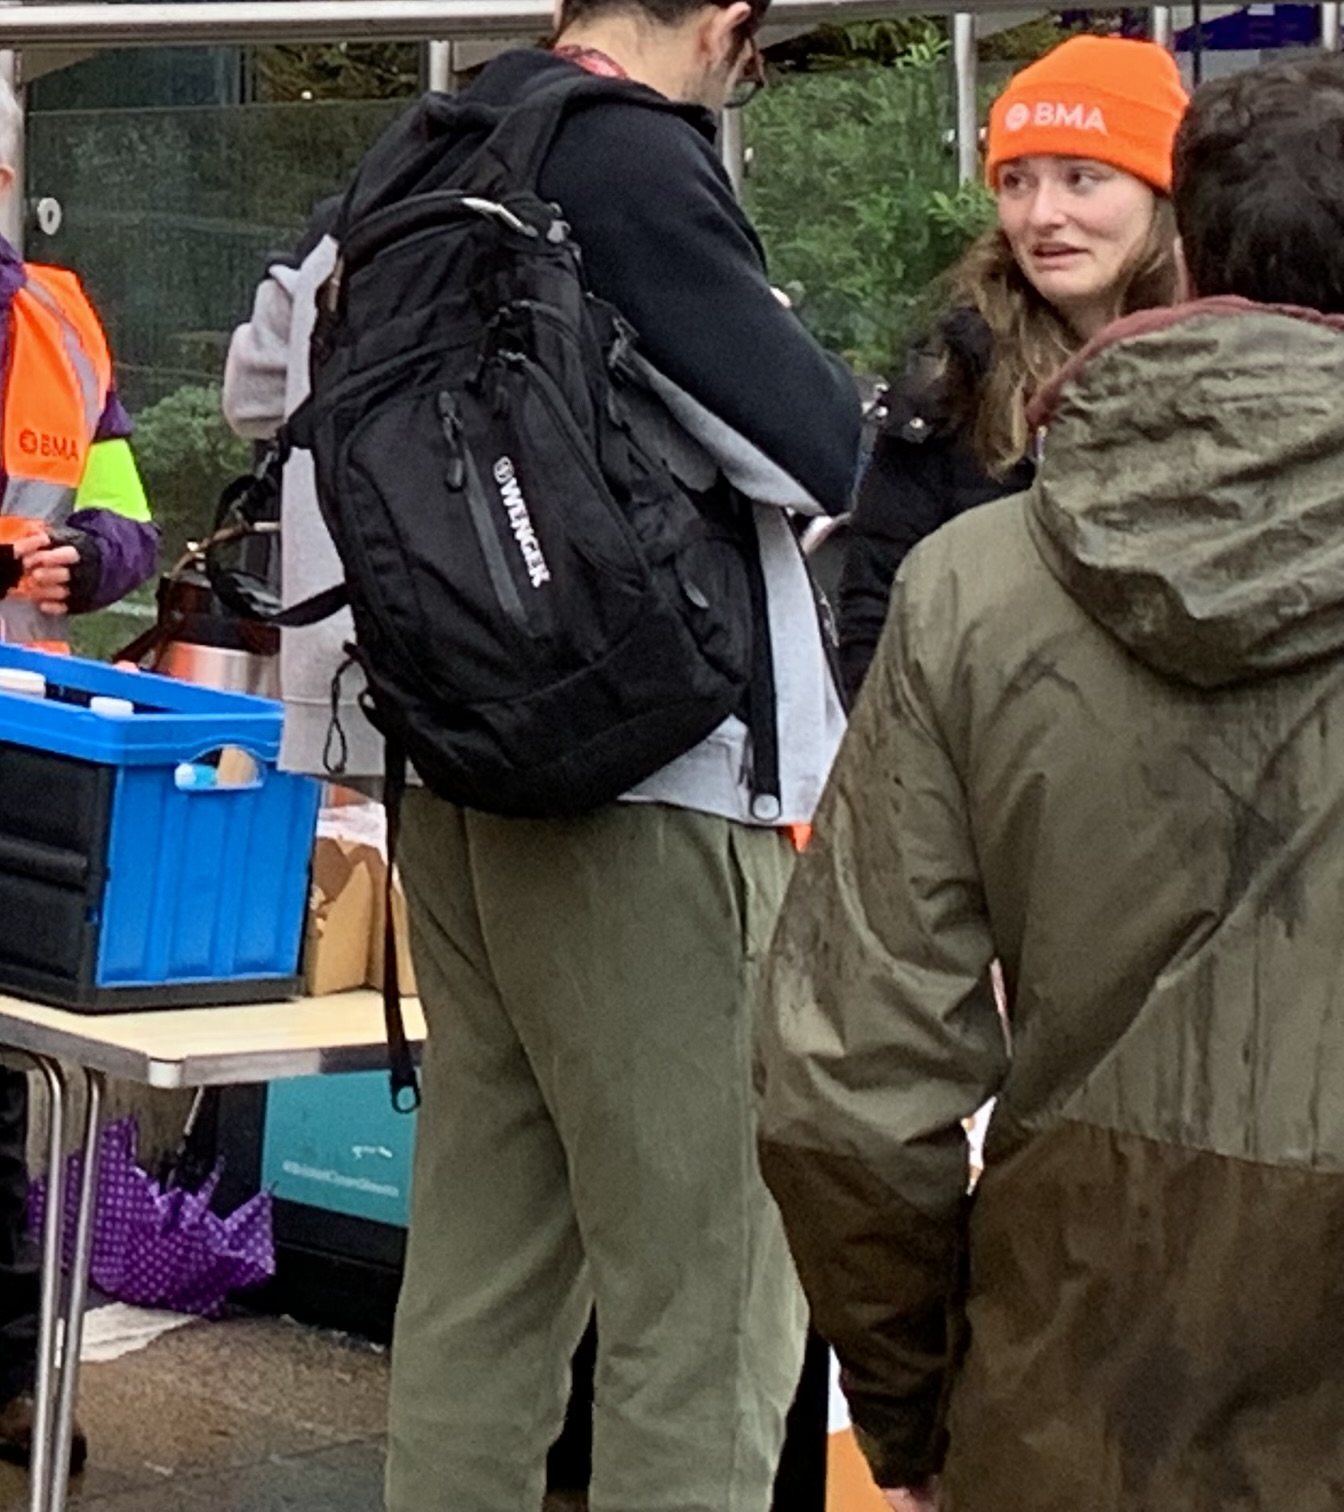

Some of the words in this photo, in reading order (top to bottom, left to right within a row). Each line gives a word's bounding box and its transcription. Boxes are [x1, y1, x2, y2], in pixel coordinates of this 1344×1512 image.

[1032, 101, 1109, 137] BMA
[40, 434, 79, 462] BMA
[500, 476, 551, 588] WENGER
